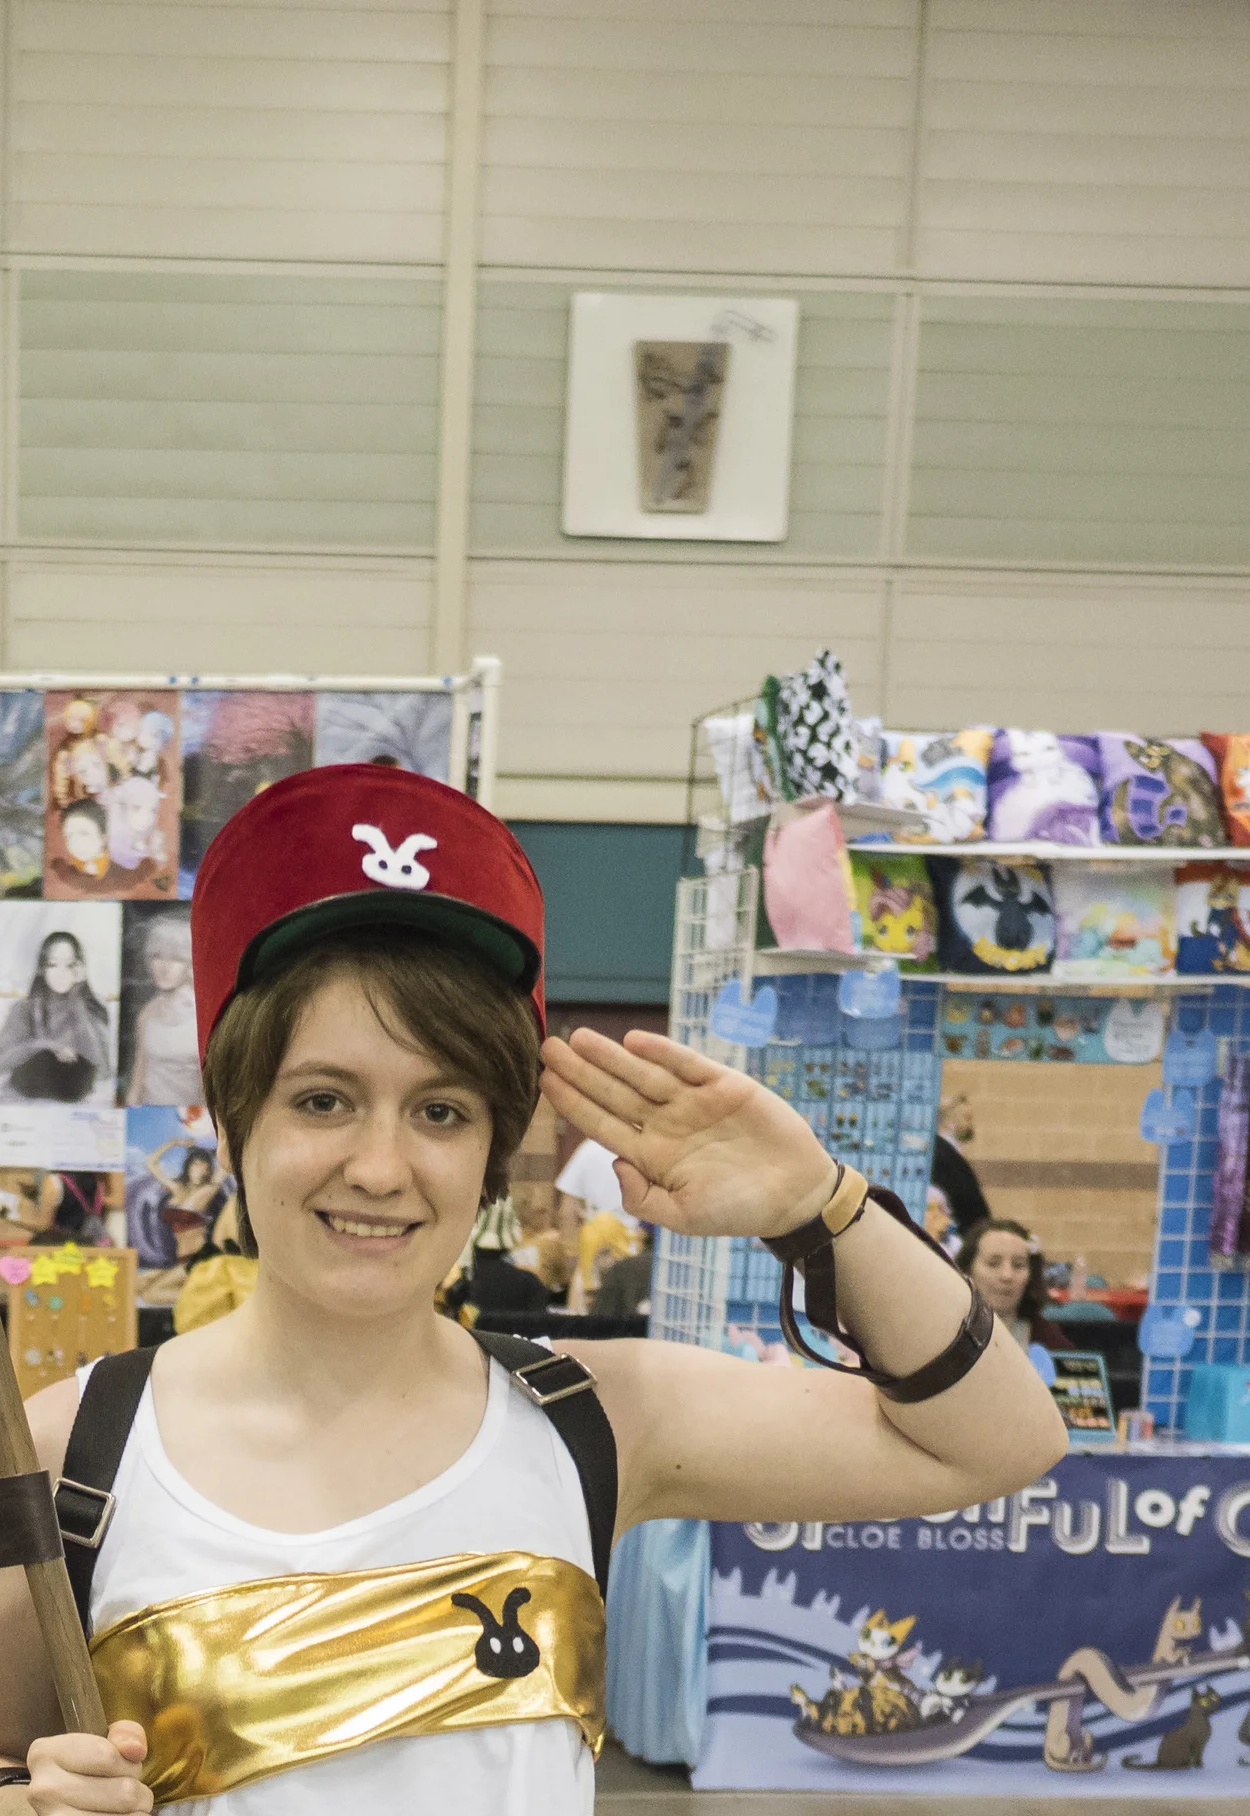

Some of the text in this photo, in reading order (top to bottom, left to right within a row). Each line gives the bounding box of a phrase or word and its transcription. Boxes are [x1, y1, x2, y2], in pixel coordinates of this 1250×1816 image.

[1134, 1484, 1211, 1537] of
[825, 1525, 901, 1550] CLOE
[916, 1526, 1005, 1551] BLOSS
